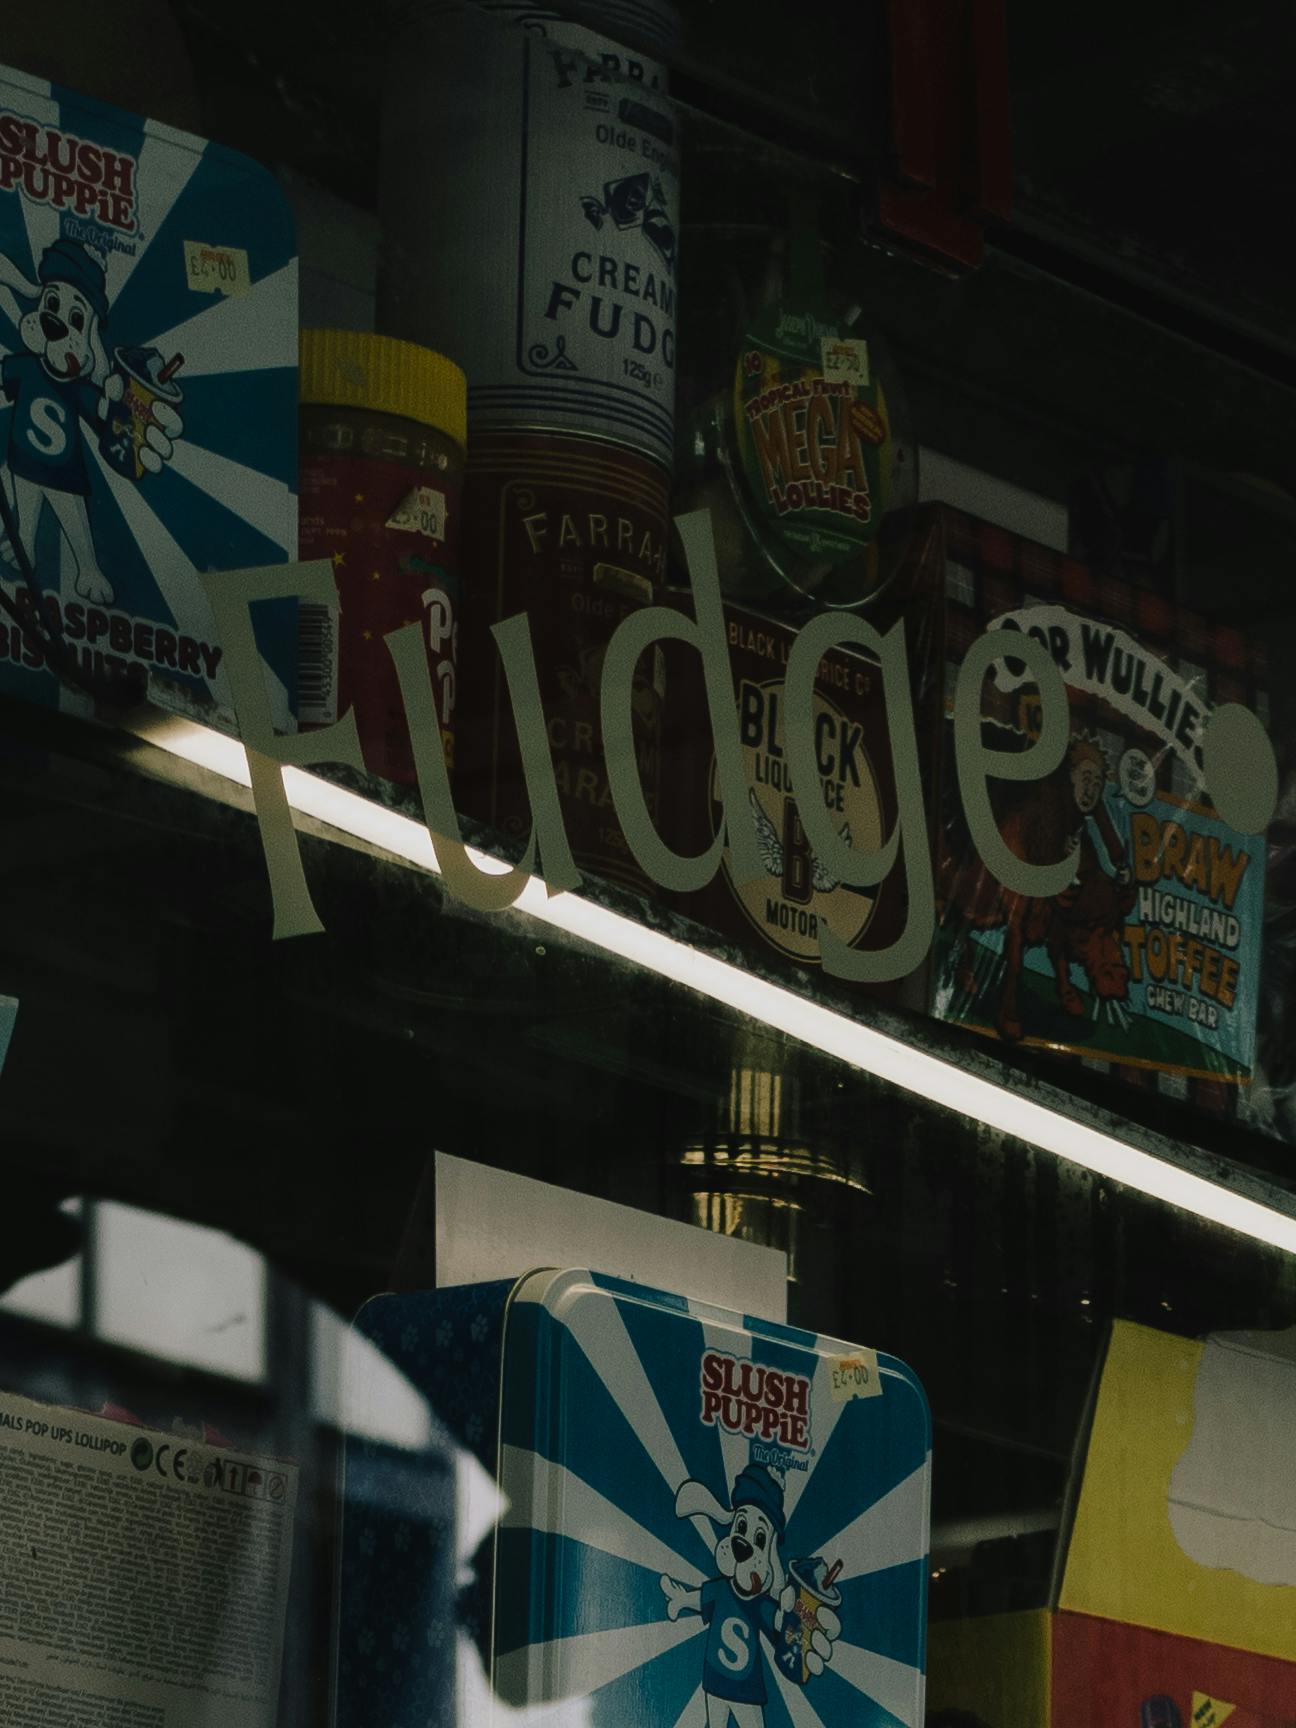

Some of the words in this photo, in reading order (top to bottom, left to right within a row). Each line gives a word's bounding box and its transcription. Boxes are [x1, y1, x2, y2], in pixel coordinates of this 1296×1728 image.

[596, 123, 637, 152] Olde
[750, 393, 870, 504] MEGA
[769, 479, 872, 524] LOLLIES
[194, 507, 1072, 983] Fudge
[740, 681, 864, 788] BLCK
[1129, 811, 1251, 909] BRAW
[1137, 887, 1241, 951] HIGHLAND
[1123, 924, 1241, 1009] TOFFEE
[1145, 984, 1188, 1015] CHEW
[1188, 991, 1219, 1031] BAR
[702, 1353, 810, 1417] SLUSH
[25, 1417, 50, 1437] POP
[50, 1424, 74, 1444] UPS
[74, 1430, 128, 1458] LOLLIPOP
